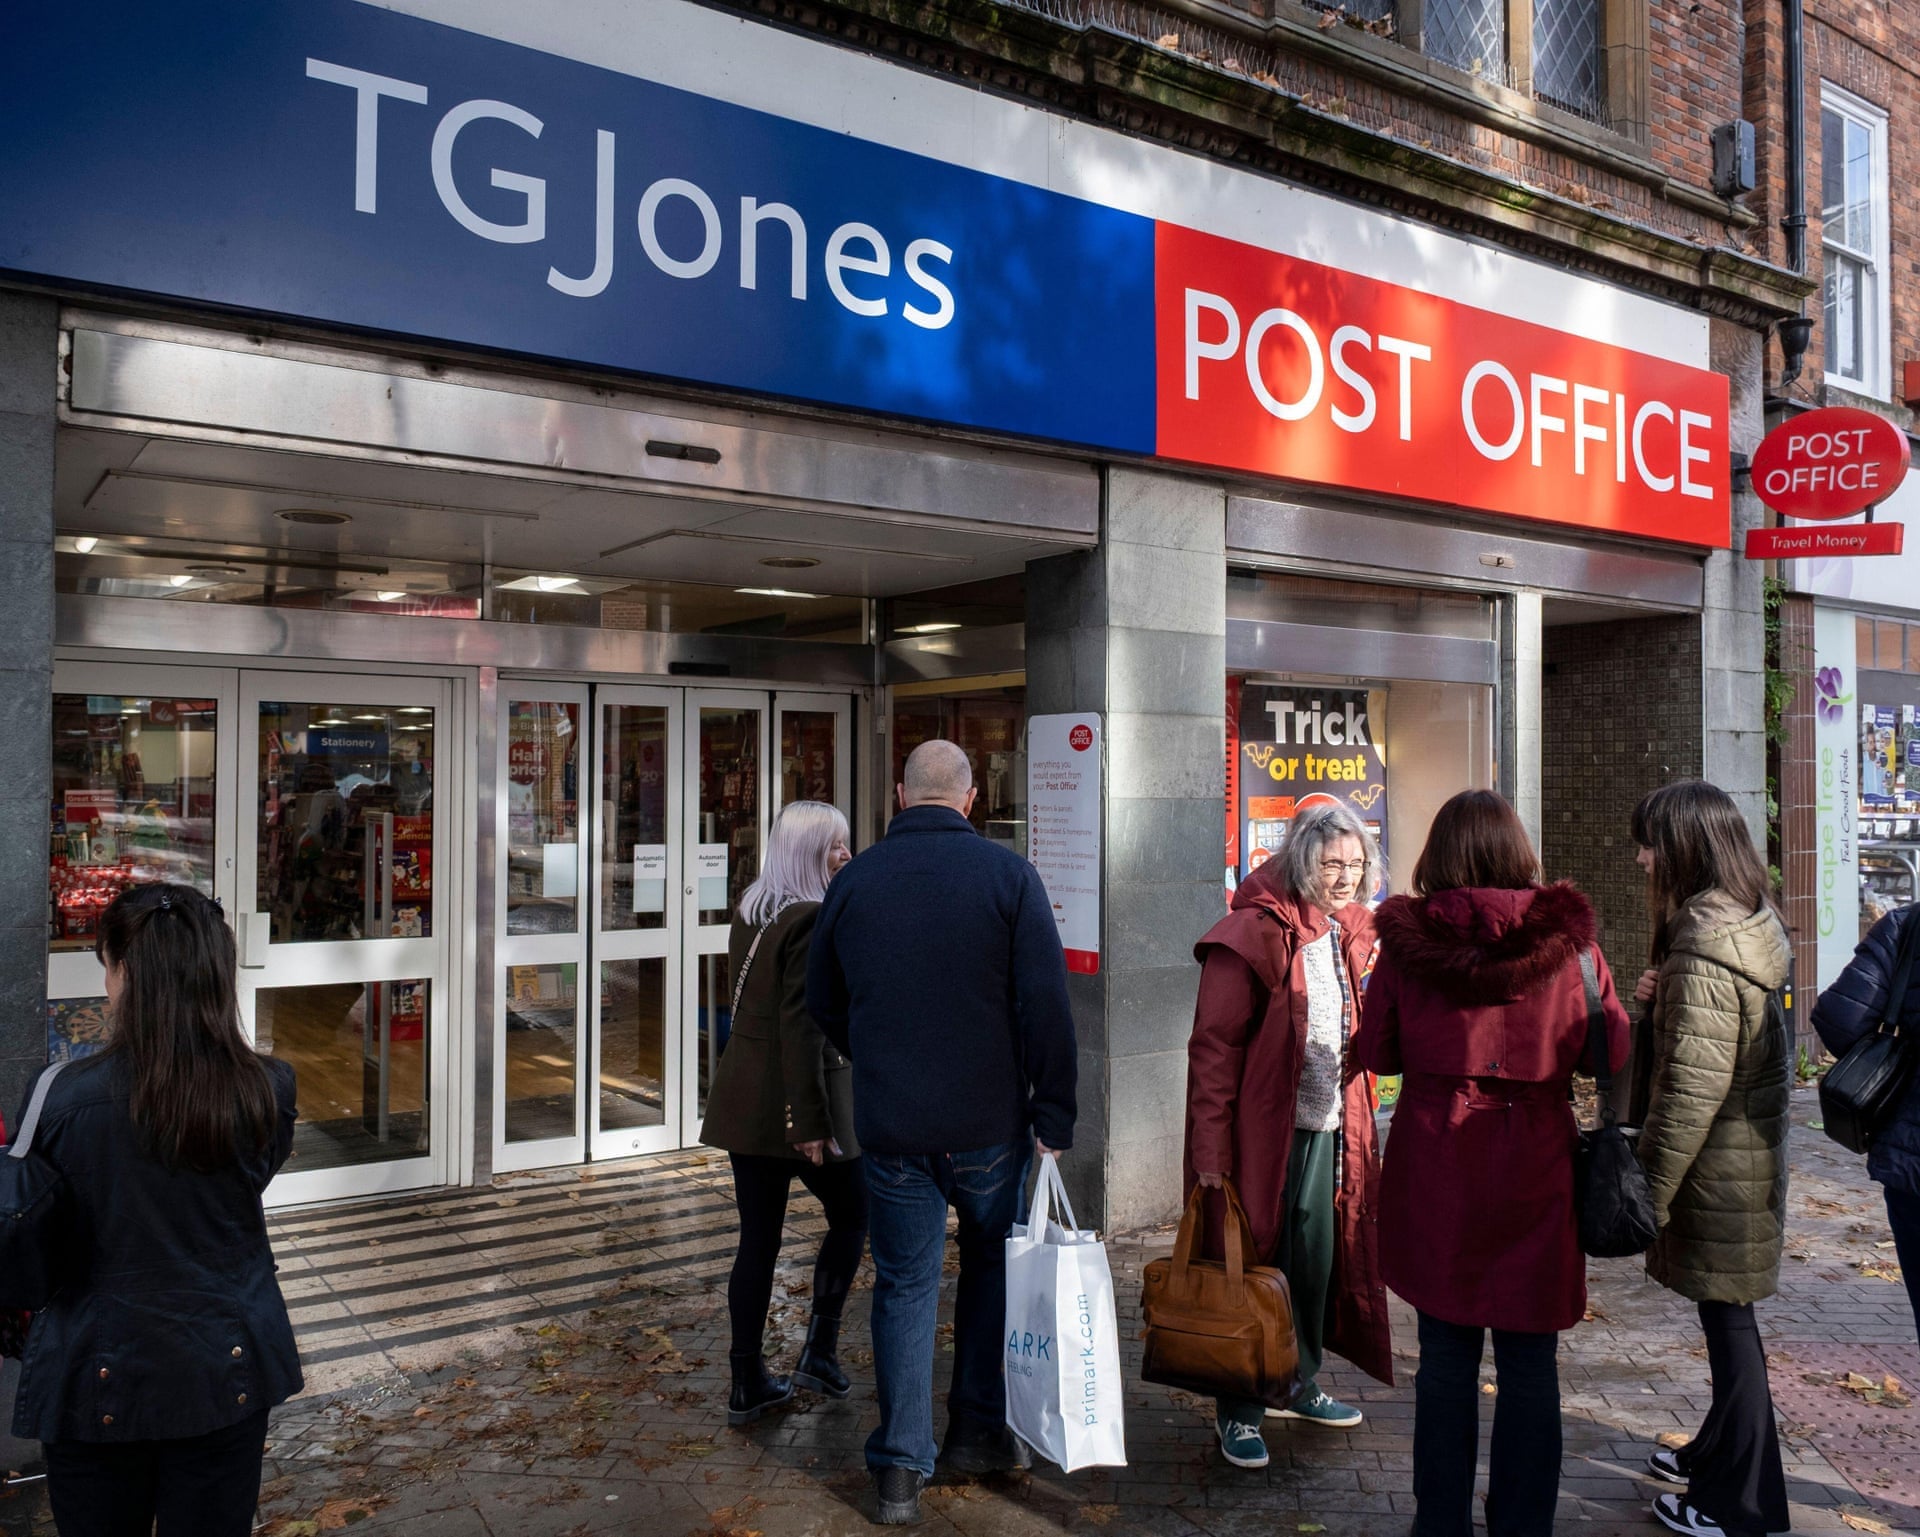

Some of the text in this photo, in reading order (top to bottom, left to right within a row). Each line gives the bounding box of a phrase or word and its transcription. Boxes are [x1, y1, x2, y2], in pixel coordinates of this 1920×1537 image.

[1183, 288, 1714, 500] POST OFFICE
[1786, 428, 1873, 462] POST
[1764, 461, 1881, 496] OFFICE
[1770, 533, 1867, 550] Travel Money
[1074, 729, 1088, 737] POST
[1265, 699, 1369, 746] Trick
[321, 737, 376, 749] Stationery
[1071, 737, 1091, 745] OFFICE
[512, 748, 544, 762] Half
[1268, 752, 1367, 781] or treat
[509, 763, 546, 778] price
[1046, 782, 1059, 790] Post
[1840, 748, 1850, 866] Feel Good Foods
[398, 823, 431, 831] Advent
[1817, 747, 1838, 937] Grape Tree
[1077, 1293, 1098, 1426] primark.com
